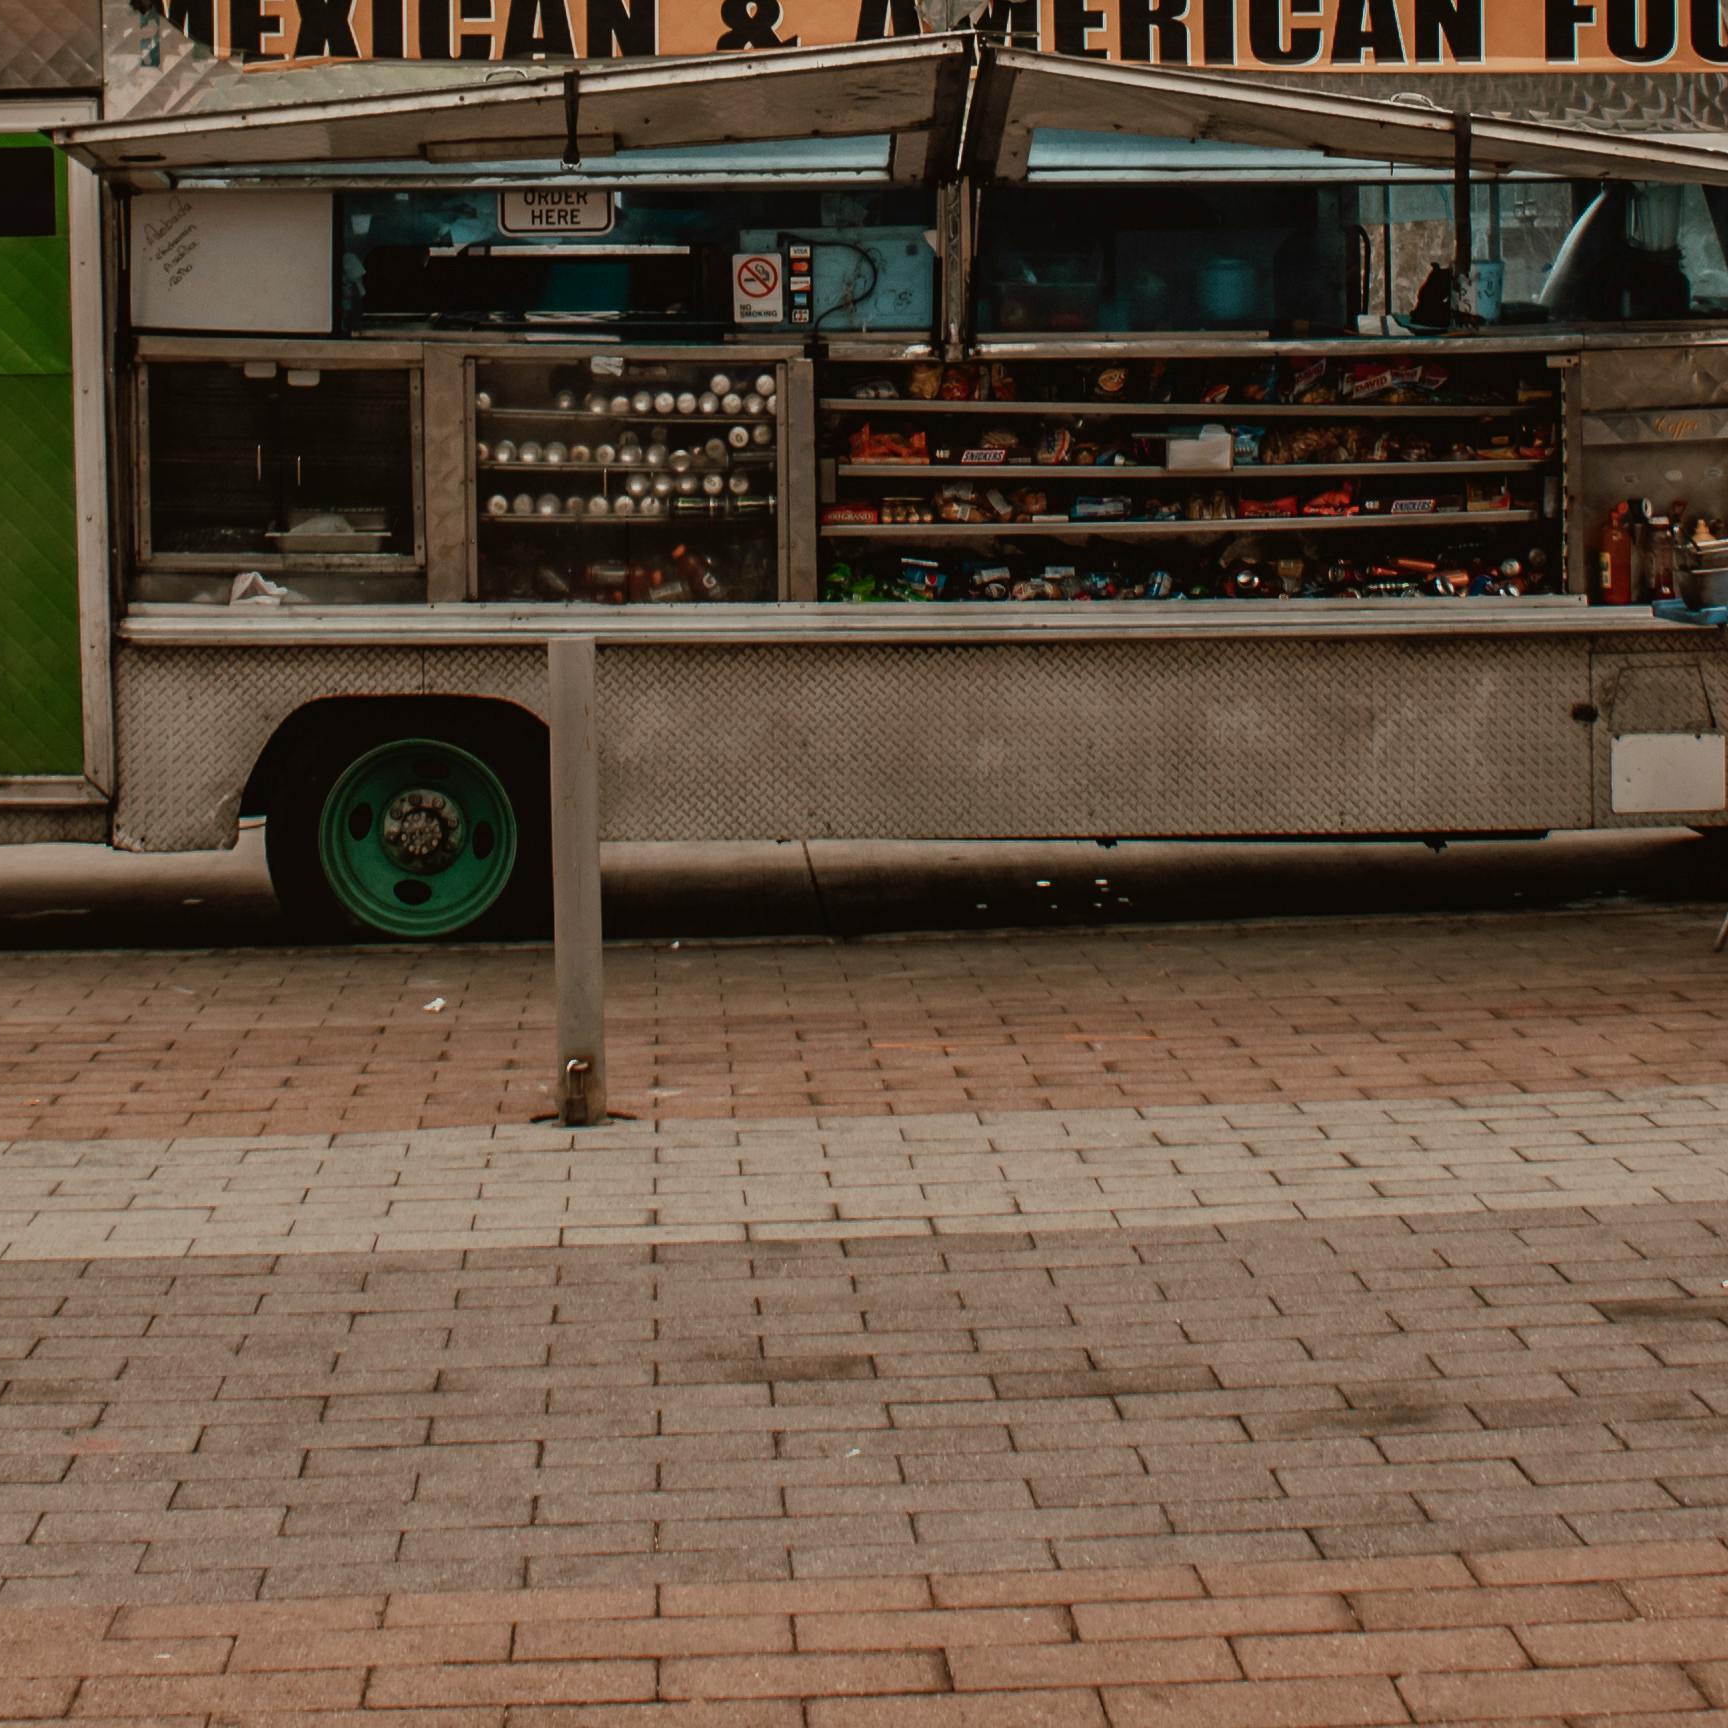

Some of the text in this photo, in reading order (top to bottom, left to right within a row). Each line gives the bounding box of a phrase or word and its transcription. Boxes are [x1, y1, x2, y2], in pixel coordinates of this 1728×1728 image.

[524, 191, 588, 206] ORDER
[531, 209, 581, 225] HERE
[740, 310, 778, 319] SMOKING
[964, 450, 1002, 462] SNICKERS
